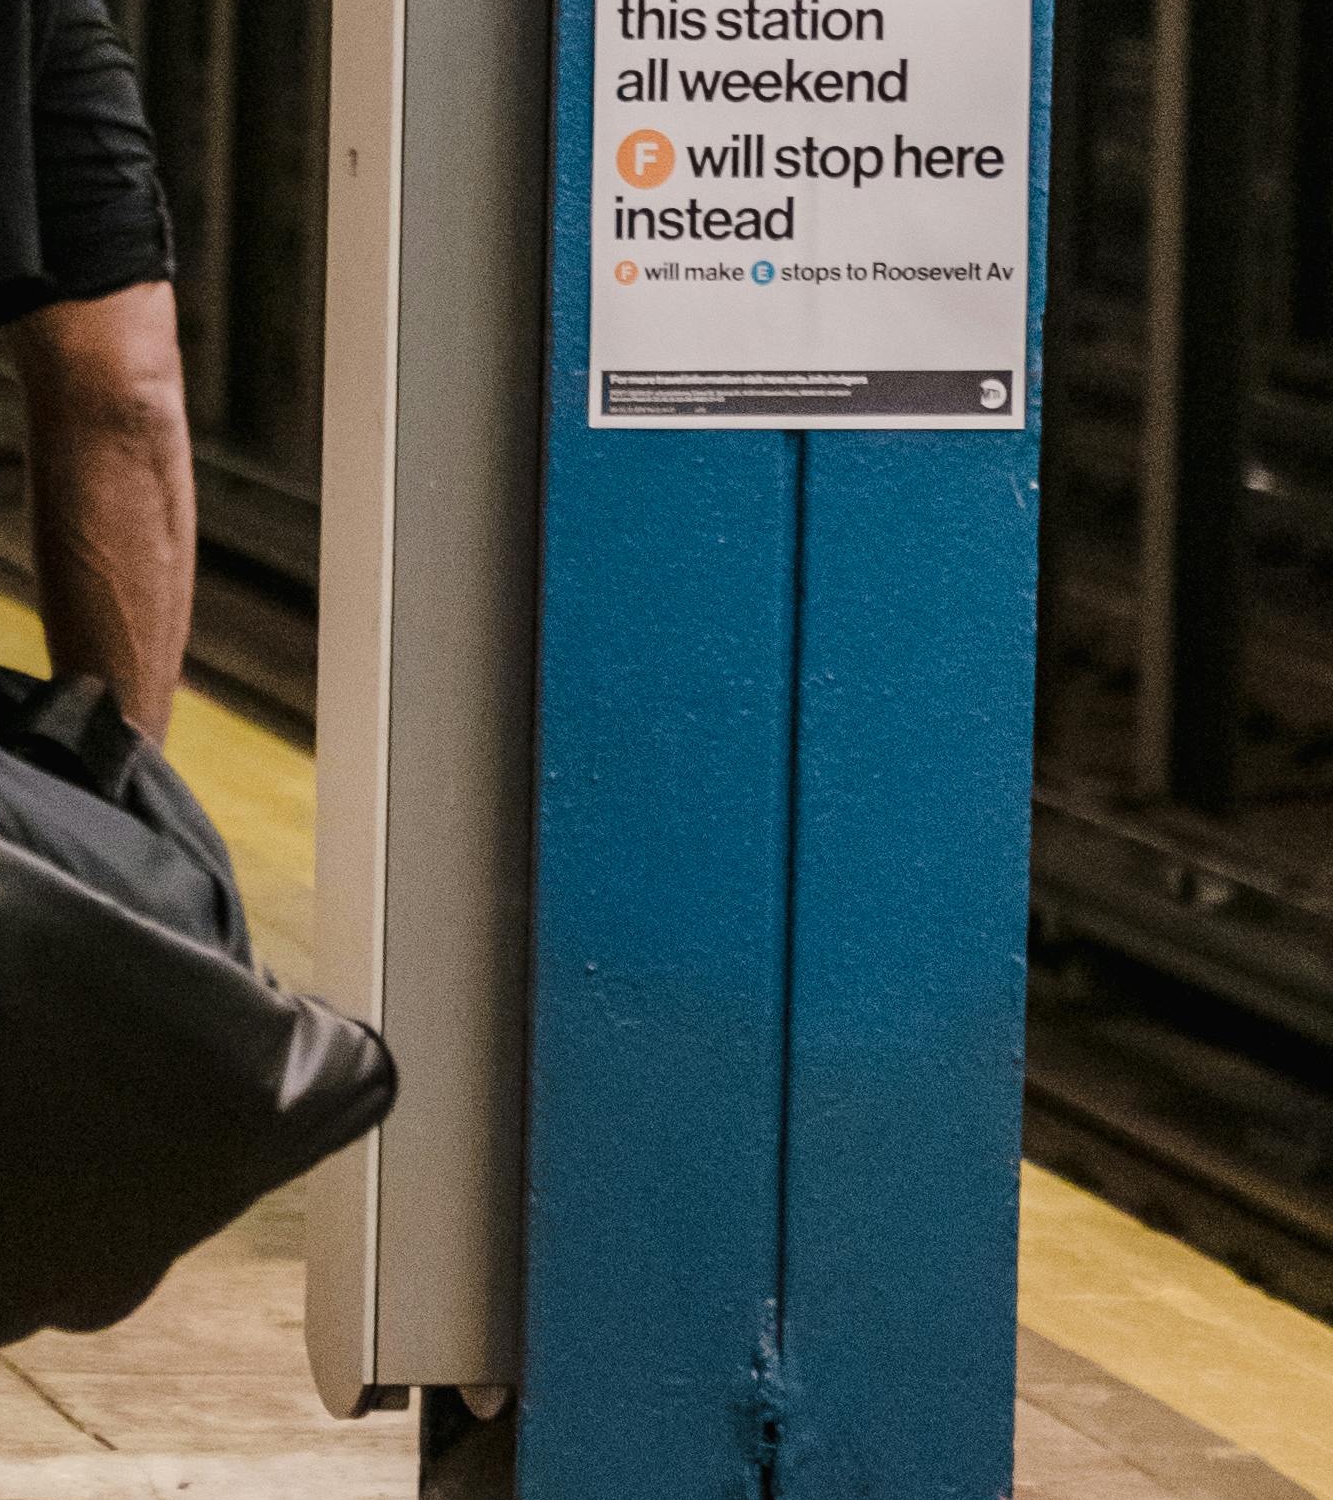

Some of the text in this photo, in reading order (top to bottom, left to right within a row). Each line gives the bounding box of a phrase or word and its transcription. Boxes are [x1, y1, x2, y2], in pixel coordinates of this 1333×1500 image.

[616, 58, 909, 103] all weekend
[635, 134, 1005, 188] F will stop here
[615, 196, 795, 241] instead
[644, 262, 680, 282] will
[684, 262, 745, 282] make
[781, 263, 841, 285] stops
[846, 263, 868, 282] to
[872, 262, 982, 282] Roosevelt
[986, 262, 1015, 282] Av
